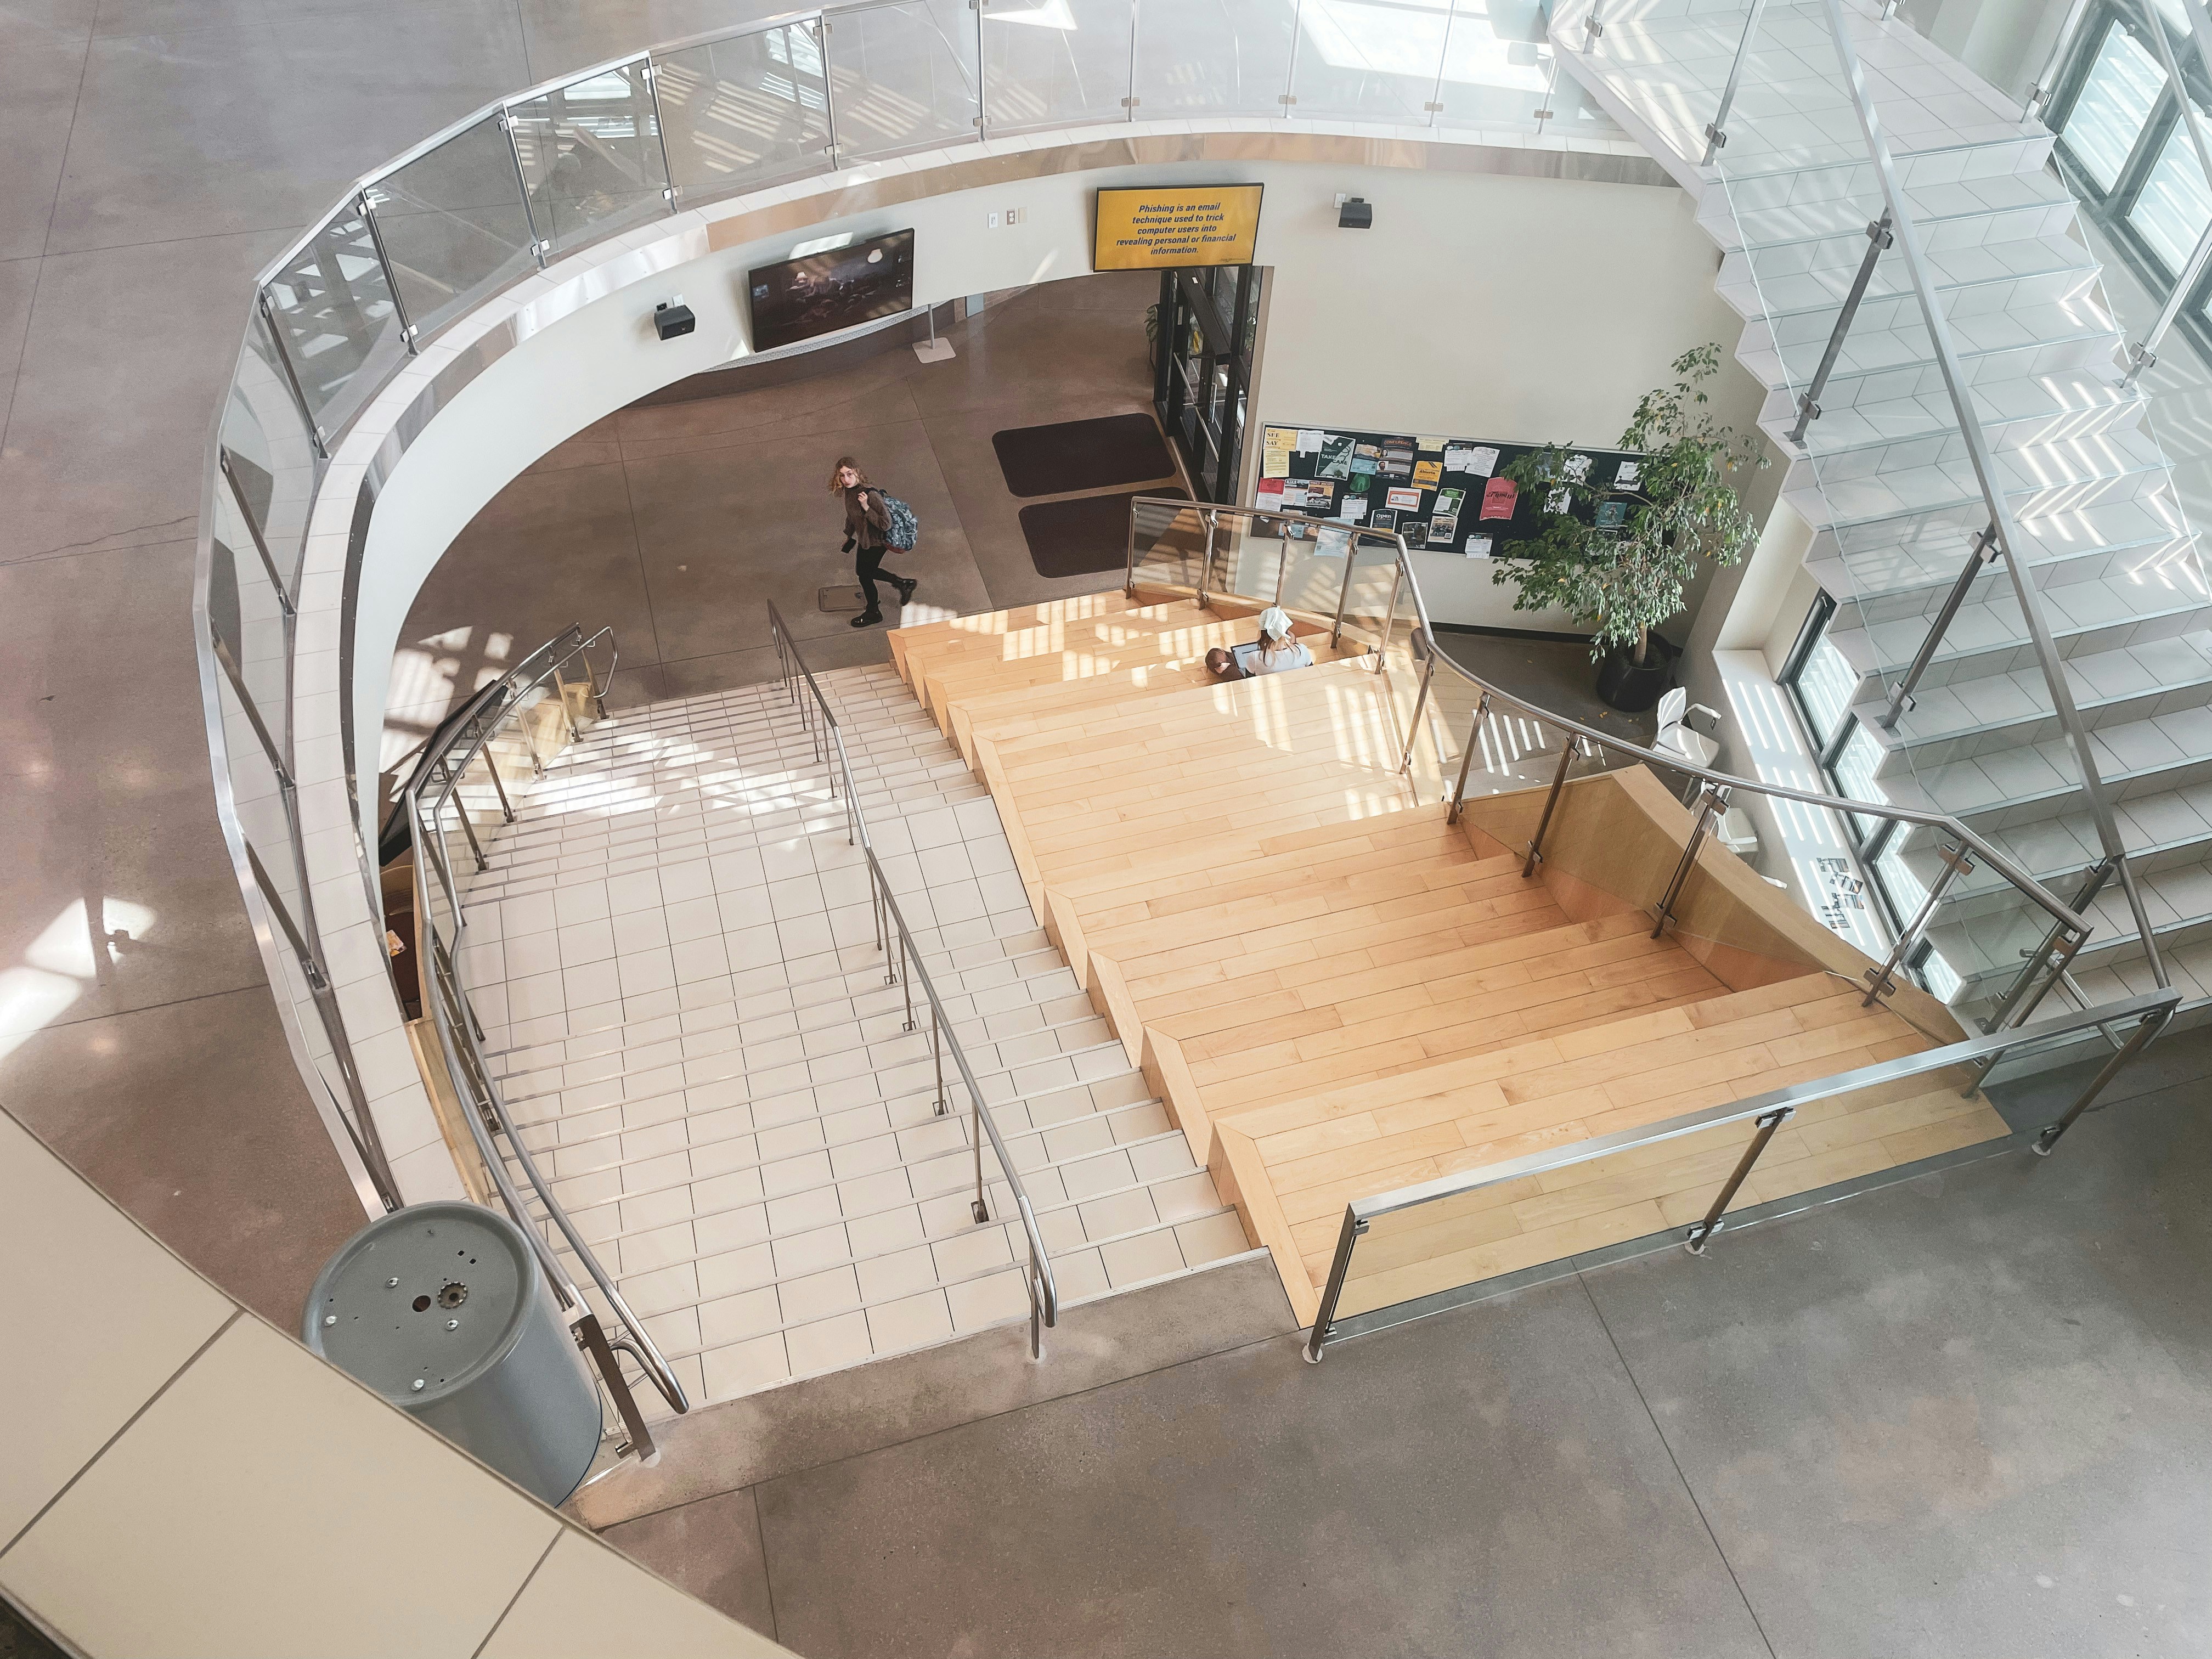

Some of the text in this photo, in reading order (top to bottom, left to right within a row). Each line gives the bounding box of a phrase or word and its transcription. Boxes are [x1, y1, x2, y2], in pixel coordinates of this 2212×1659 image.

[1138, 204, 1175, 214] Phishing
[1176, 203, 1184, 212] is
[1198, 202, 1221, 211] email
[1132, 215, 1172, 225] technique
[1174, 213, 1194, 223] used
[1205, 212, 1224, 222] trick
[1137, 226, 1176, 236] computer
[1201, 224, 1217, 232] into
[1116, 236, 1153, 247] revealing
[1154, 235, 1190, 246] personal
[1201, 233, 1237, 242] financial
[1150, 245, 1199, 255] information.
